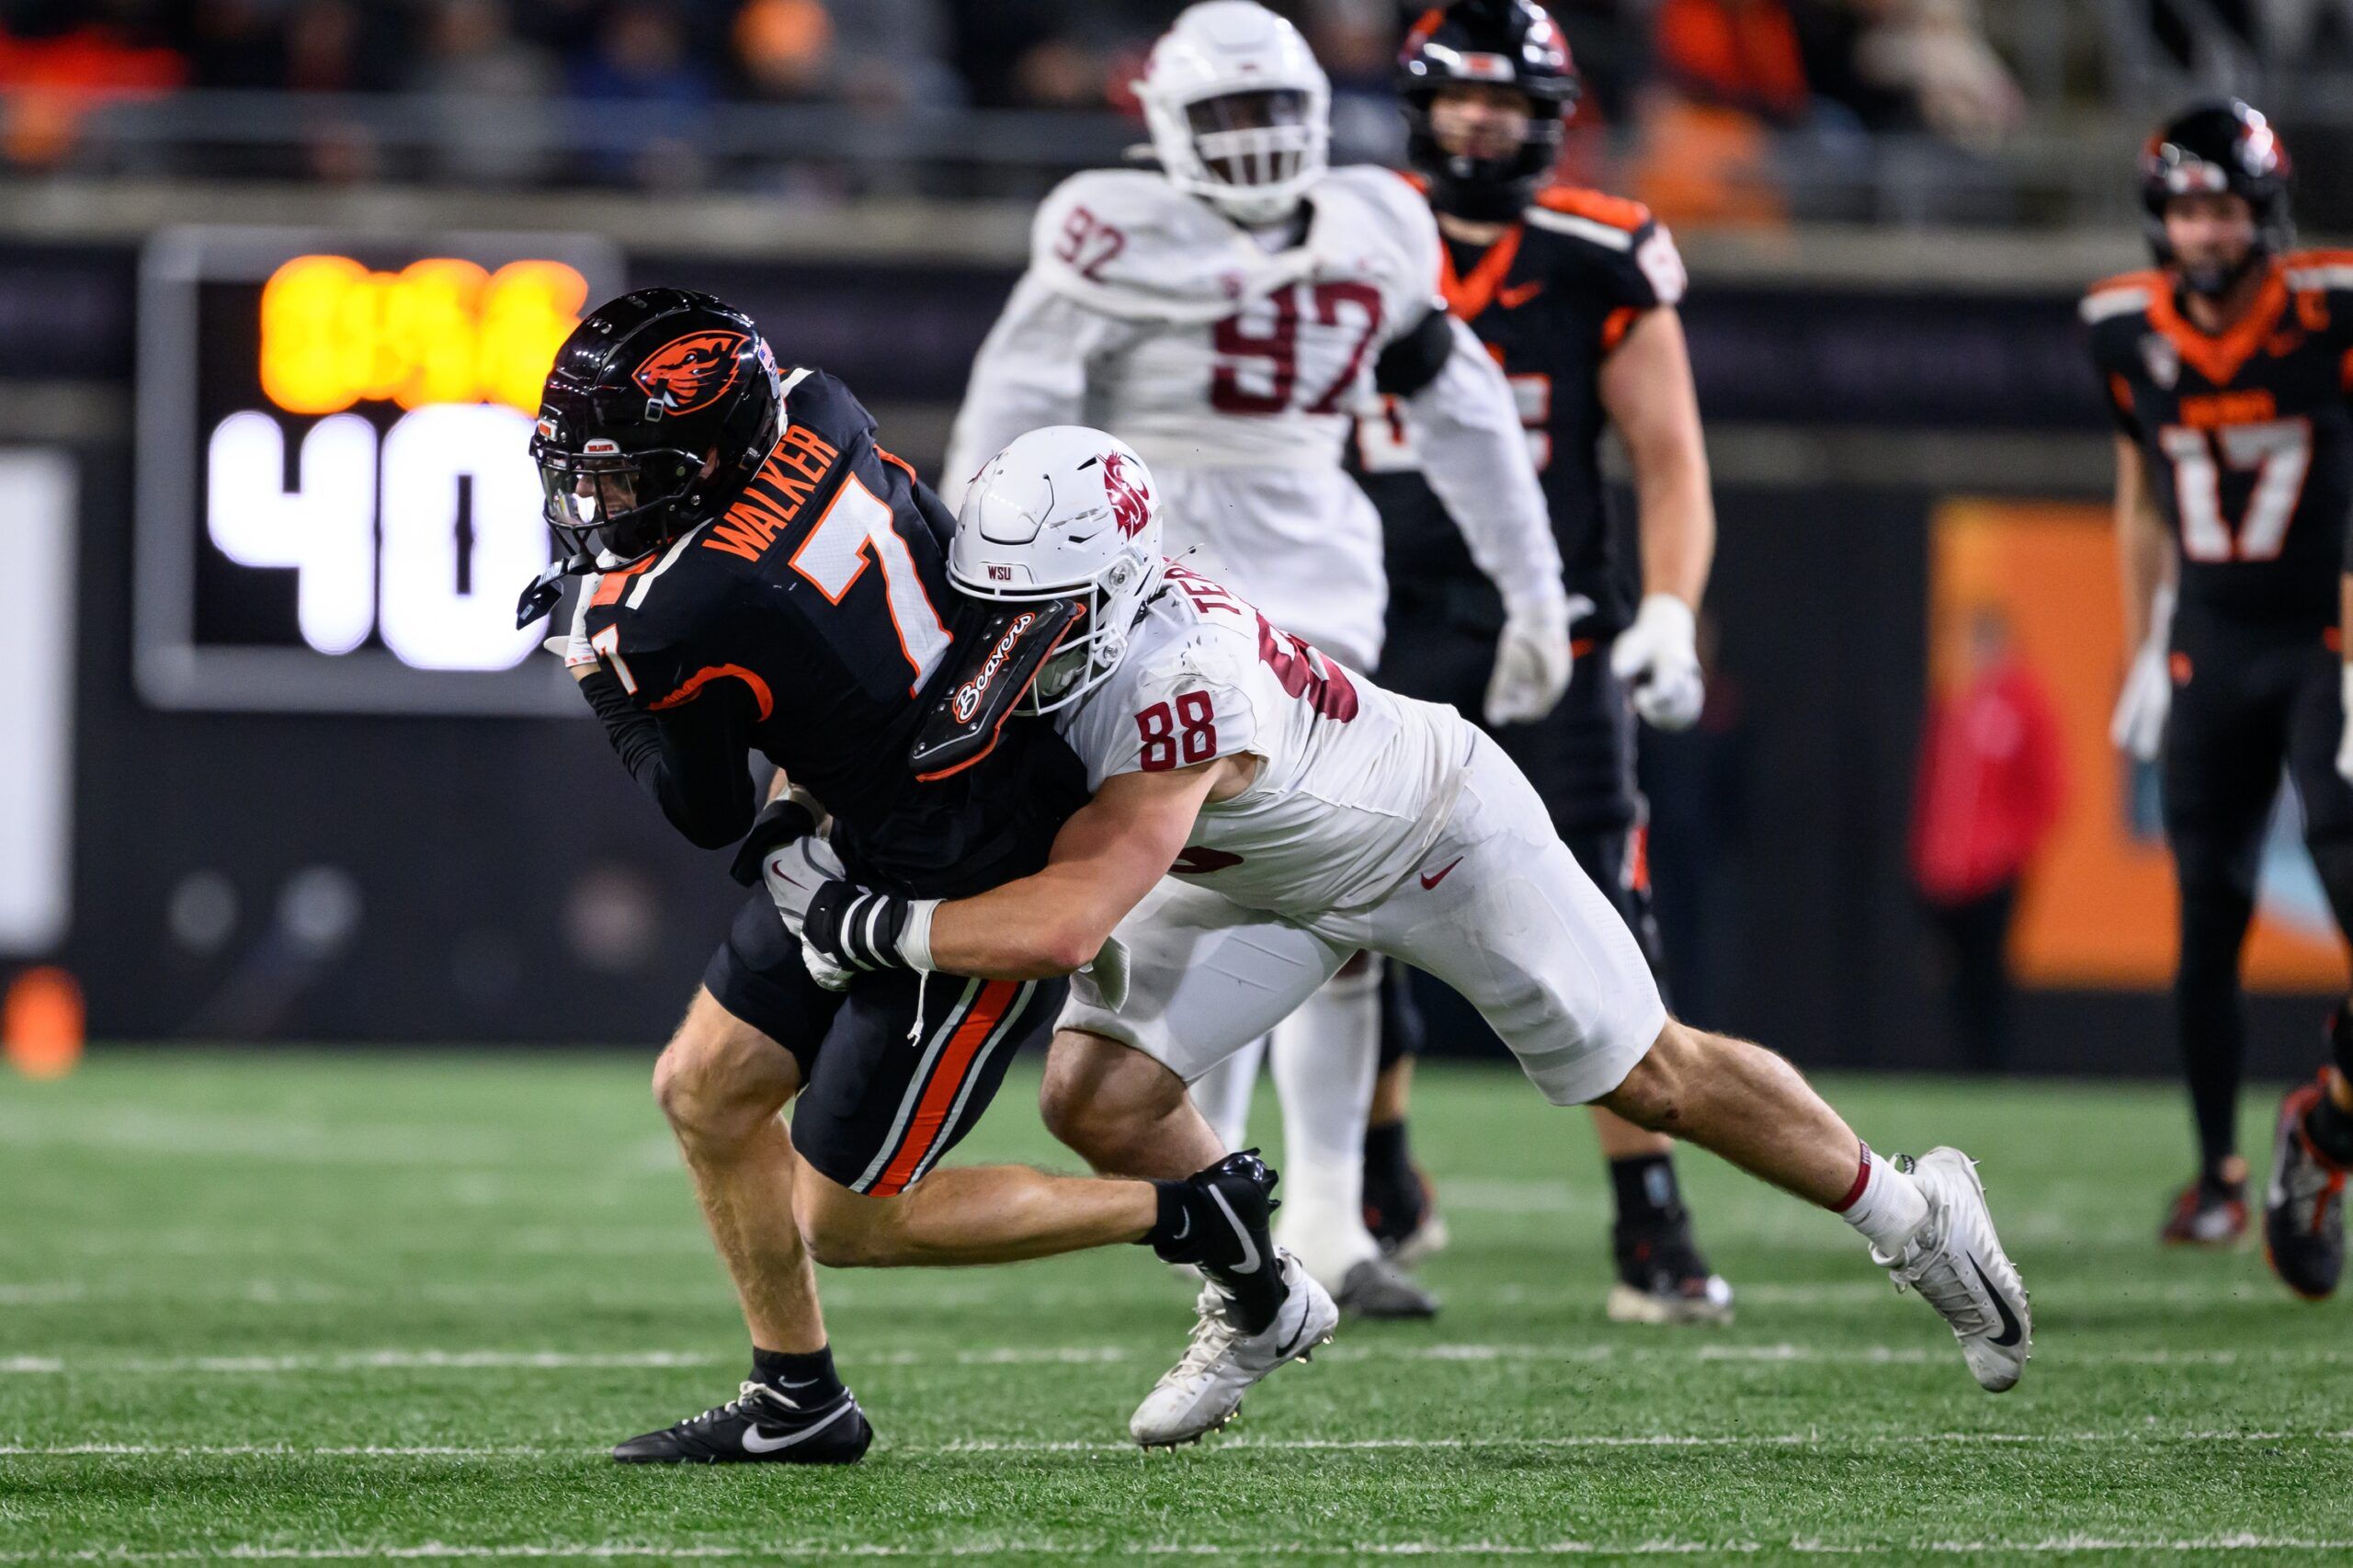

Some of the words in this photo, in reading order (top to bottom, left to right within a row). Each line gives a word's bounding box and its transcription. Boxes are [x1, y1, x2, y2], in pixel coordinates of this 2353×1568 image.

[1054, 205, 1127, 283] 92
[1211, 279, 1385, 414] 92
[208, 403, 551, 671] 40
[701, 425, 839, 562] WALKER
[2159, 415, 2313, 562] 17
[788, 471, 953, 699] 7
[987, 565, 1011, 580] WSU
[591, 623, 639, 696] 7
[952, 612, 1036, 723] Beavers
[1134, 690, 1217, 772] 88
